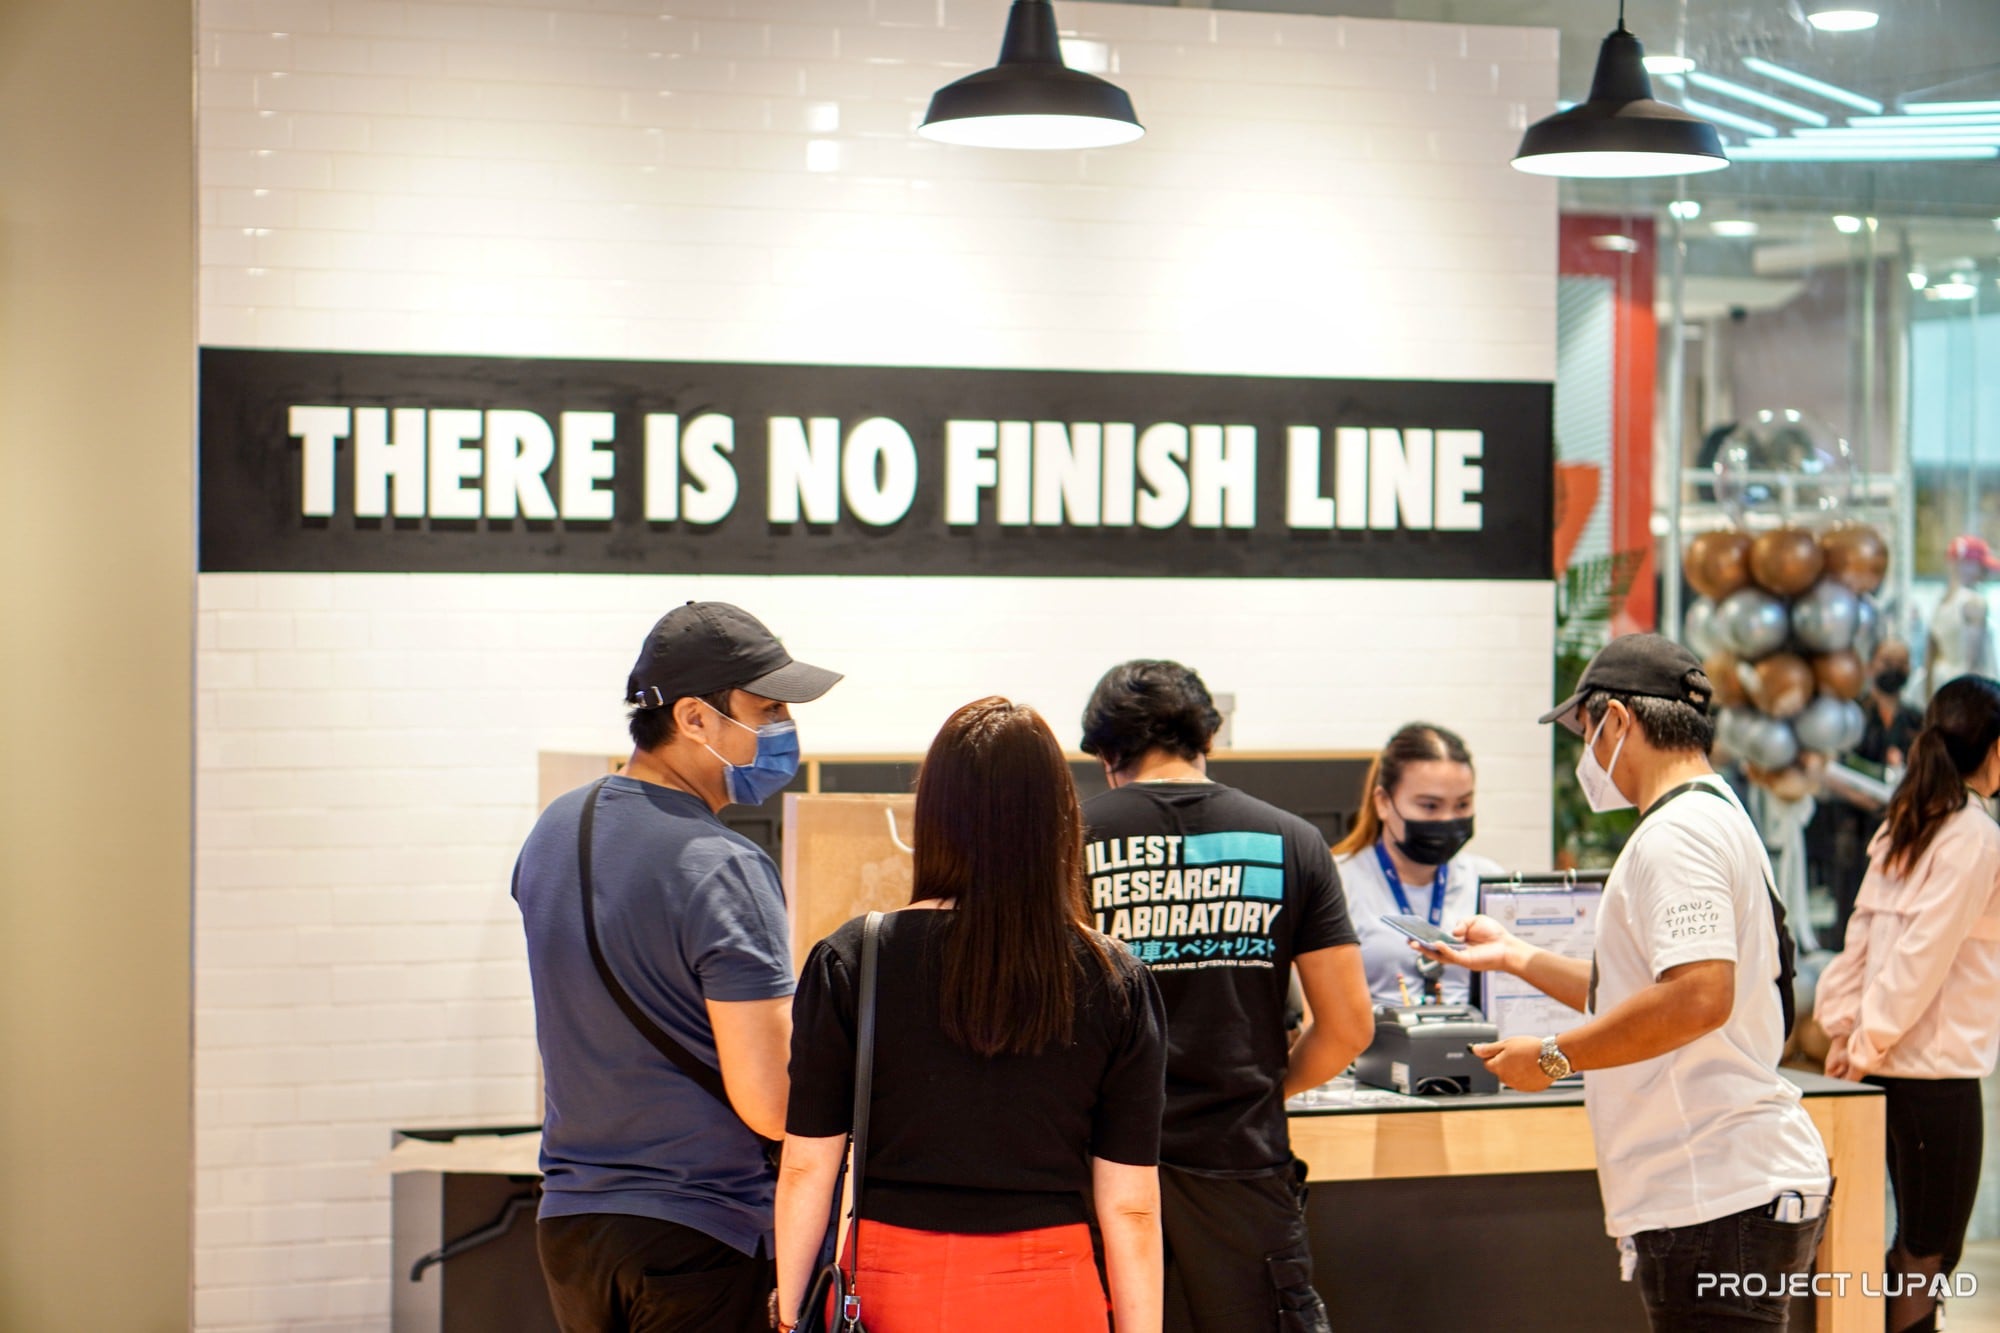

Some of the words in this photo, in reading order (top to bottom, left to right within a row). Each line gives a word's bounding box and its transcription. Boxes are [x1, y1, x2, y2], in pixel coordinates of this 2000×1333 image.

[288, 405, 615, 519] THERE
[644, 413, 739, 525] IS
[767, 416, 918, 526] NO
[945, 420, 1257, 529] FINISH
[1286, 425, 1484, 531] LINE
[1085, 834, 1182, 875] ILLEST
[1092, 864, 1243, 909] RESEARCH
[1095, 900, 1283, 941] LABORATORY
[1665, 912, 1719, 928] TOKYO
[1666, 900, 1713, 916] KAWS
[1671, 924, 1717, 939] FIRST
